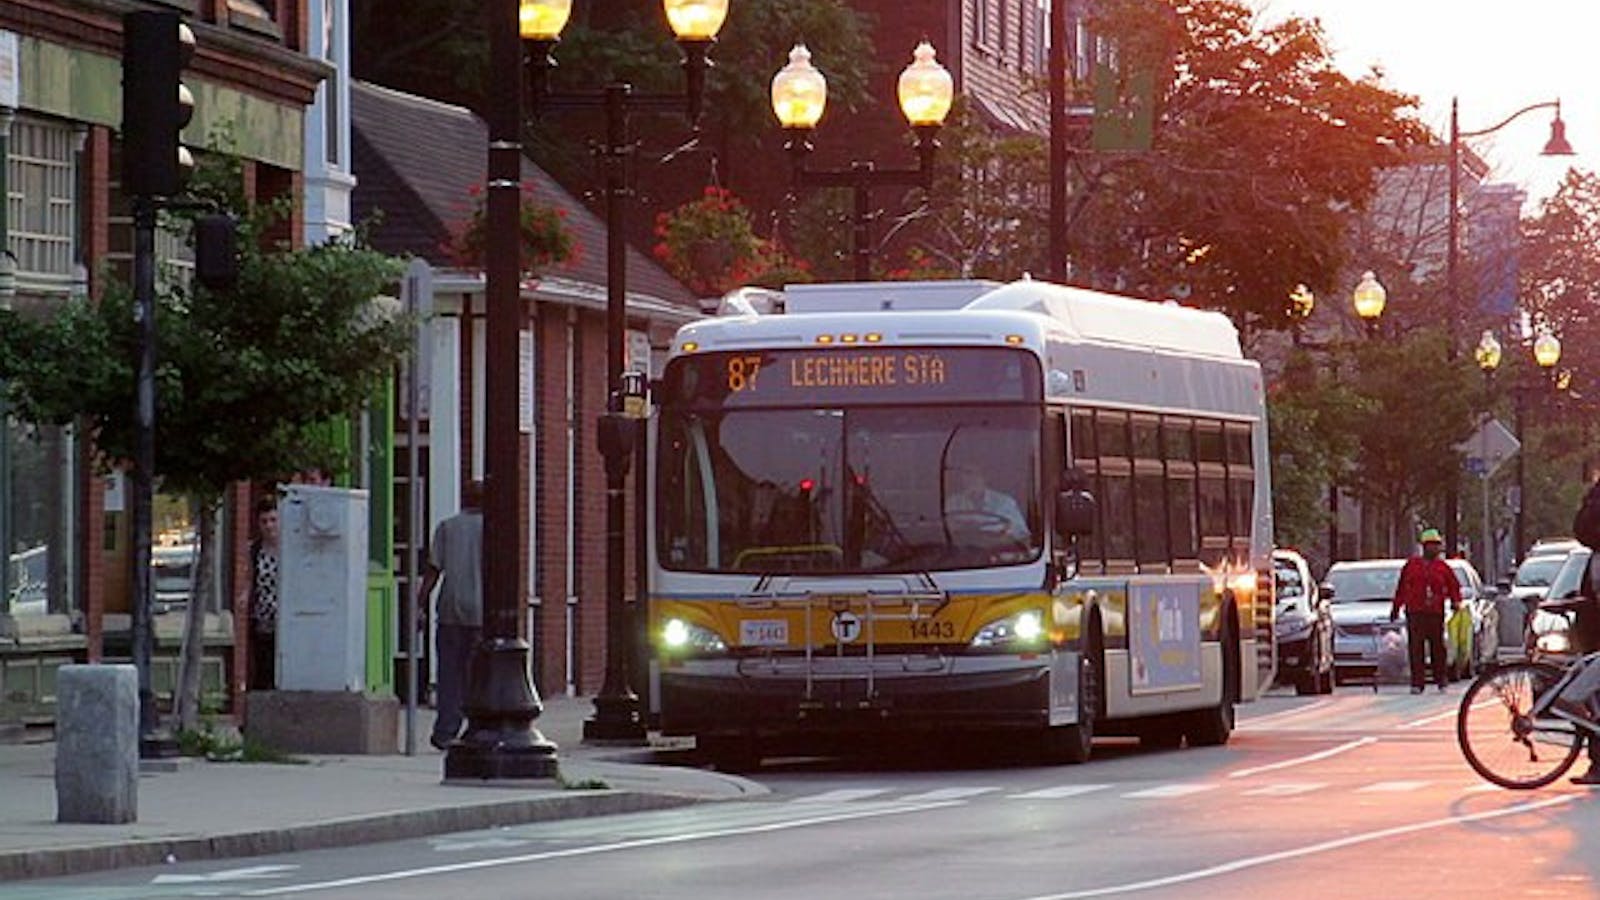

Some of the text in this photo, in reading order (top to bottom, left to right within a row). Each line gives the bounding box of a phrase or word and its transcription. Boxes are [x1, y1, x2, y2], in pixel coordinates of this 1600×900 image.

[728, 354, 944, 391] 87 LECHMERE STA
[836, 619, 856, 638] T
[910, 621, 955, 640] 1443
